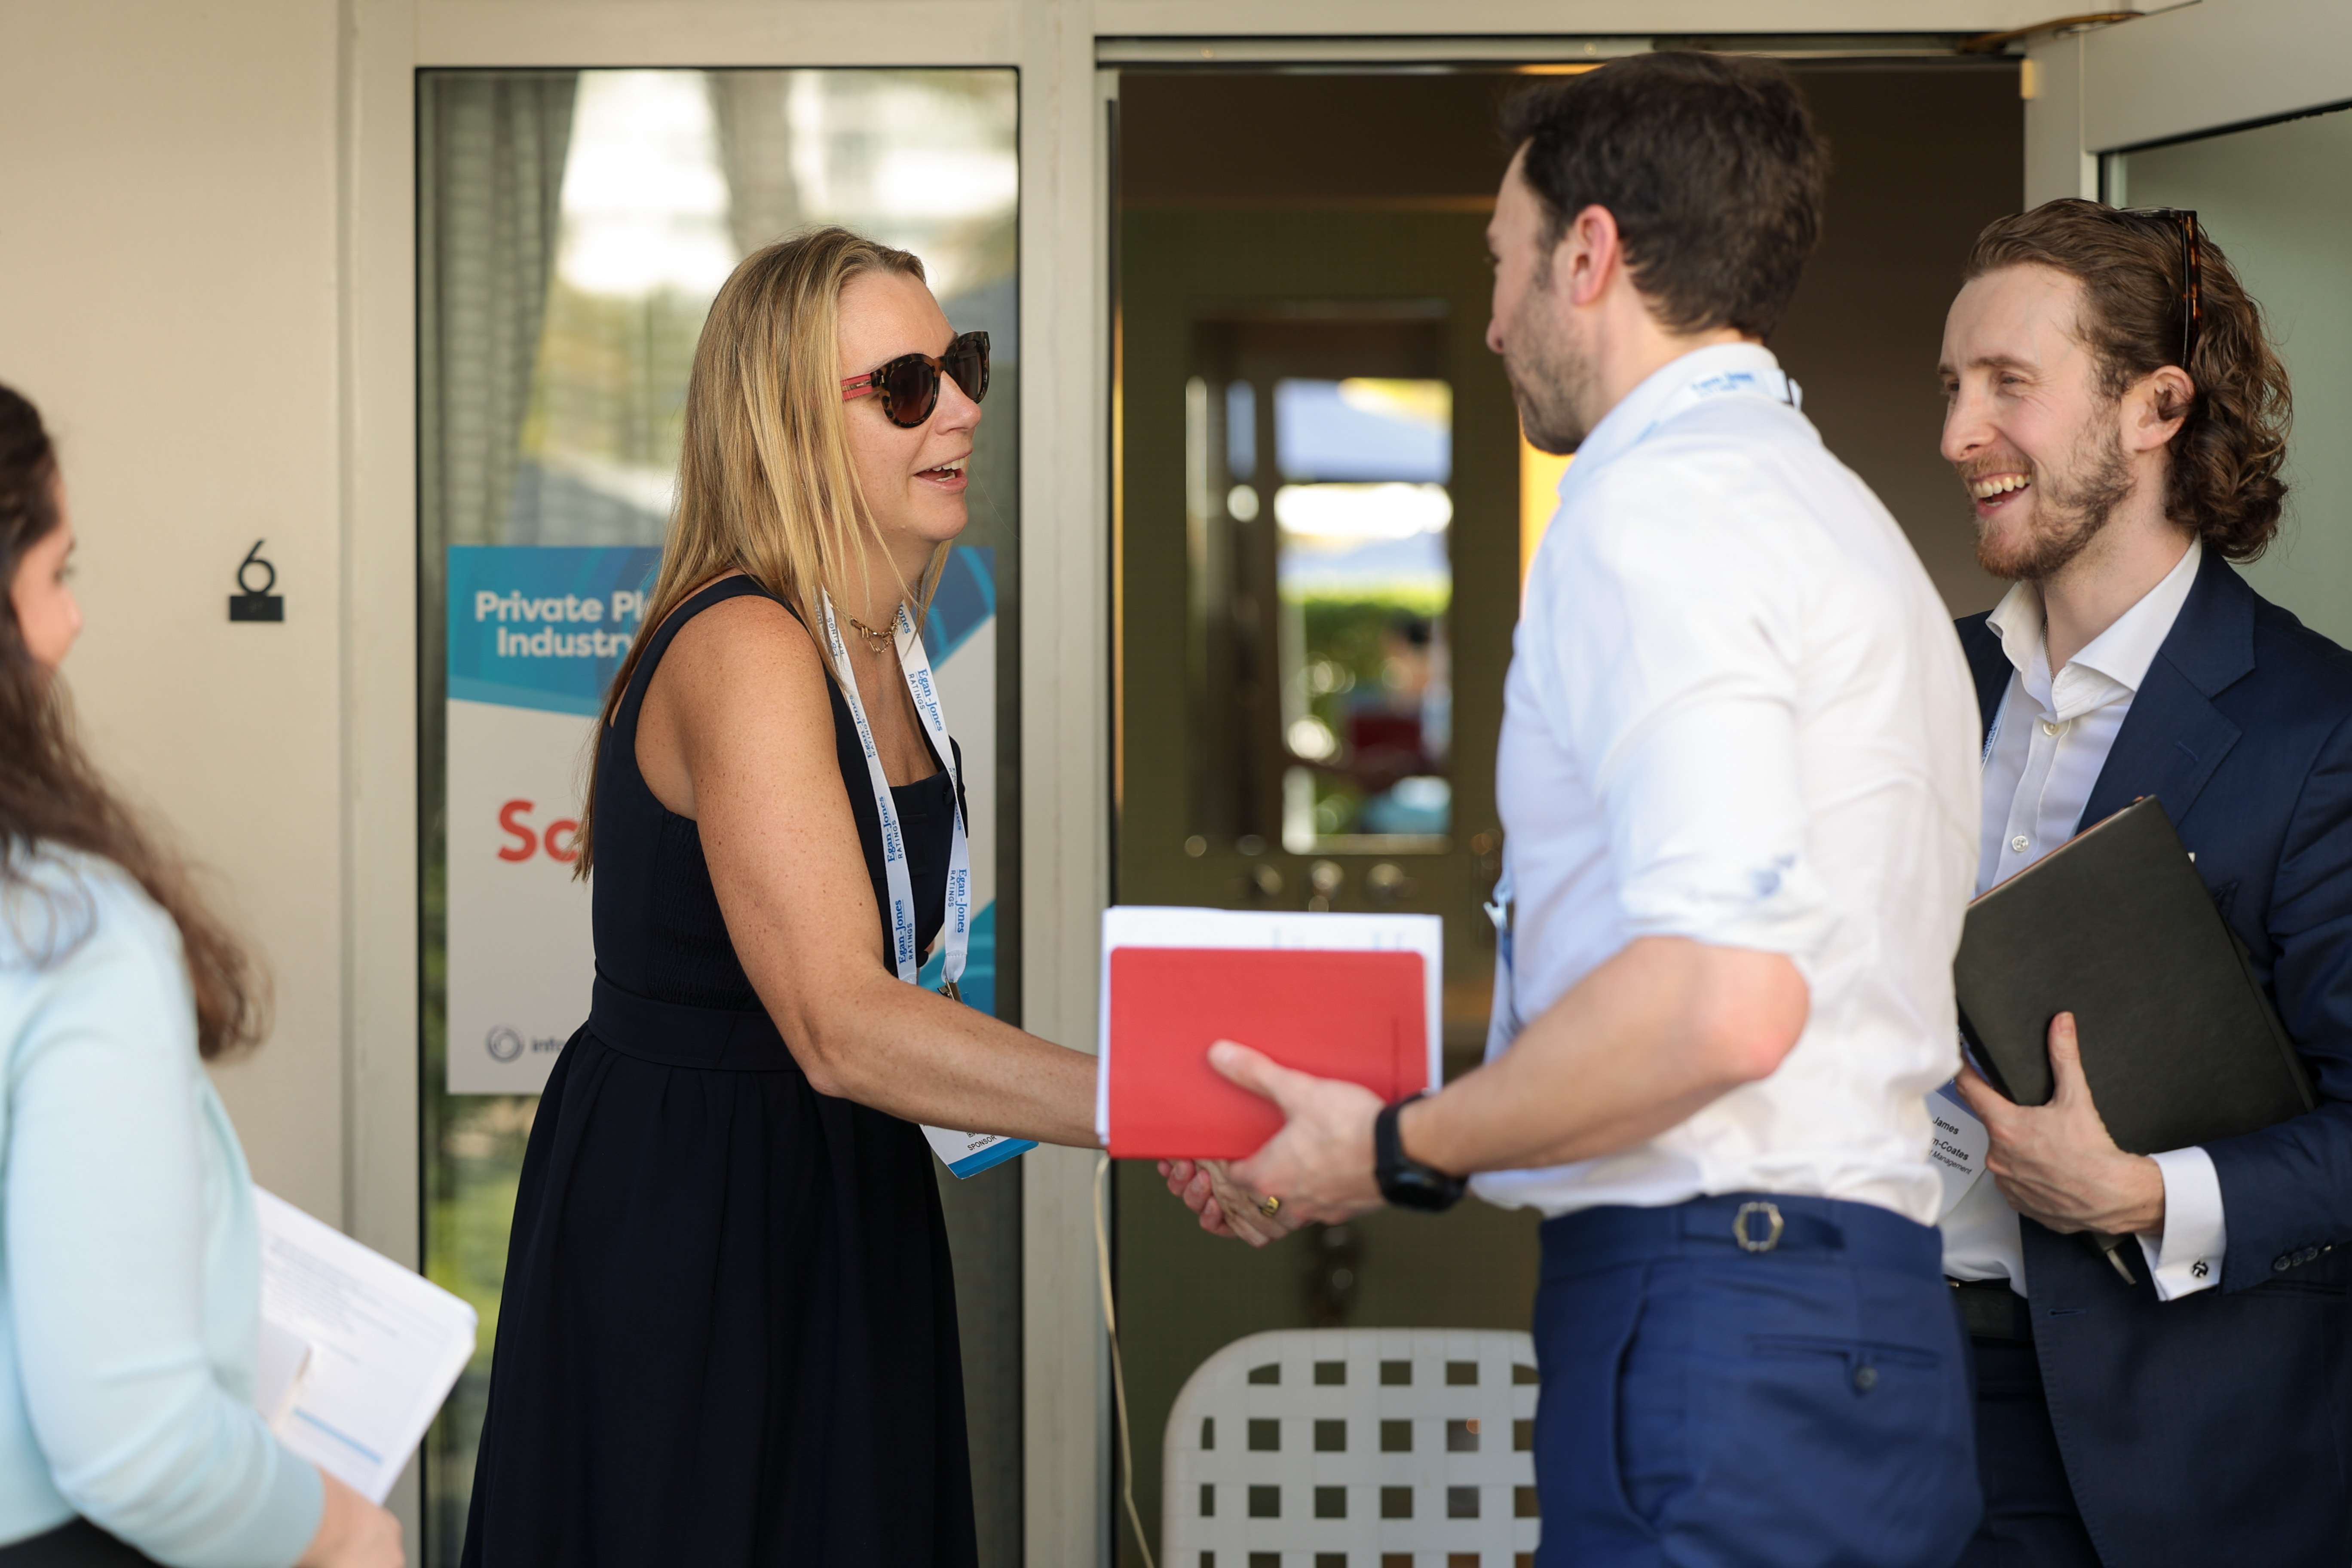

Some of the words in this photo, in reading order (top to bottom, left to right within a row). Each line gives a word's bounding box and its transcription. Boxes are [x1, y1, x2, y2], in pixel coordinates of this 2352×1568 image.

[238, 538, 275, 595] 6
[475, 589, 604, 622] Private
[908, 673, 925, 710] RATINGS
[917, 668, 943, 732] Egan-Jones
[862, 718, 876, 756] RATINGS
[879, 796, 896, 862] Egan-Jones
[892, 820, 903, 859] RATINGS
[948, 870, 956, 907] RATINGS
[956, 869, 967, 933] Egan-Jones
[894, 900, 906, 965] Egan-Jones
[968, 1135, 997, 1151] SPONSOR
[1932, 1117, 1959, 1135] James
[1932, 1151, 1972, 1175] Management
